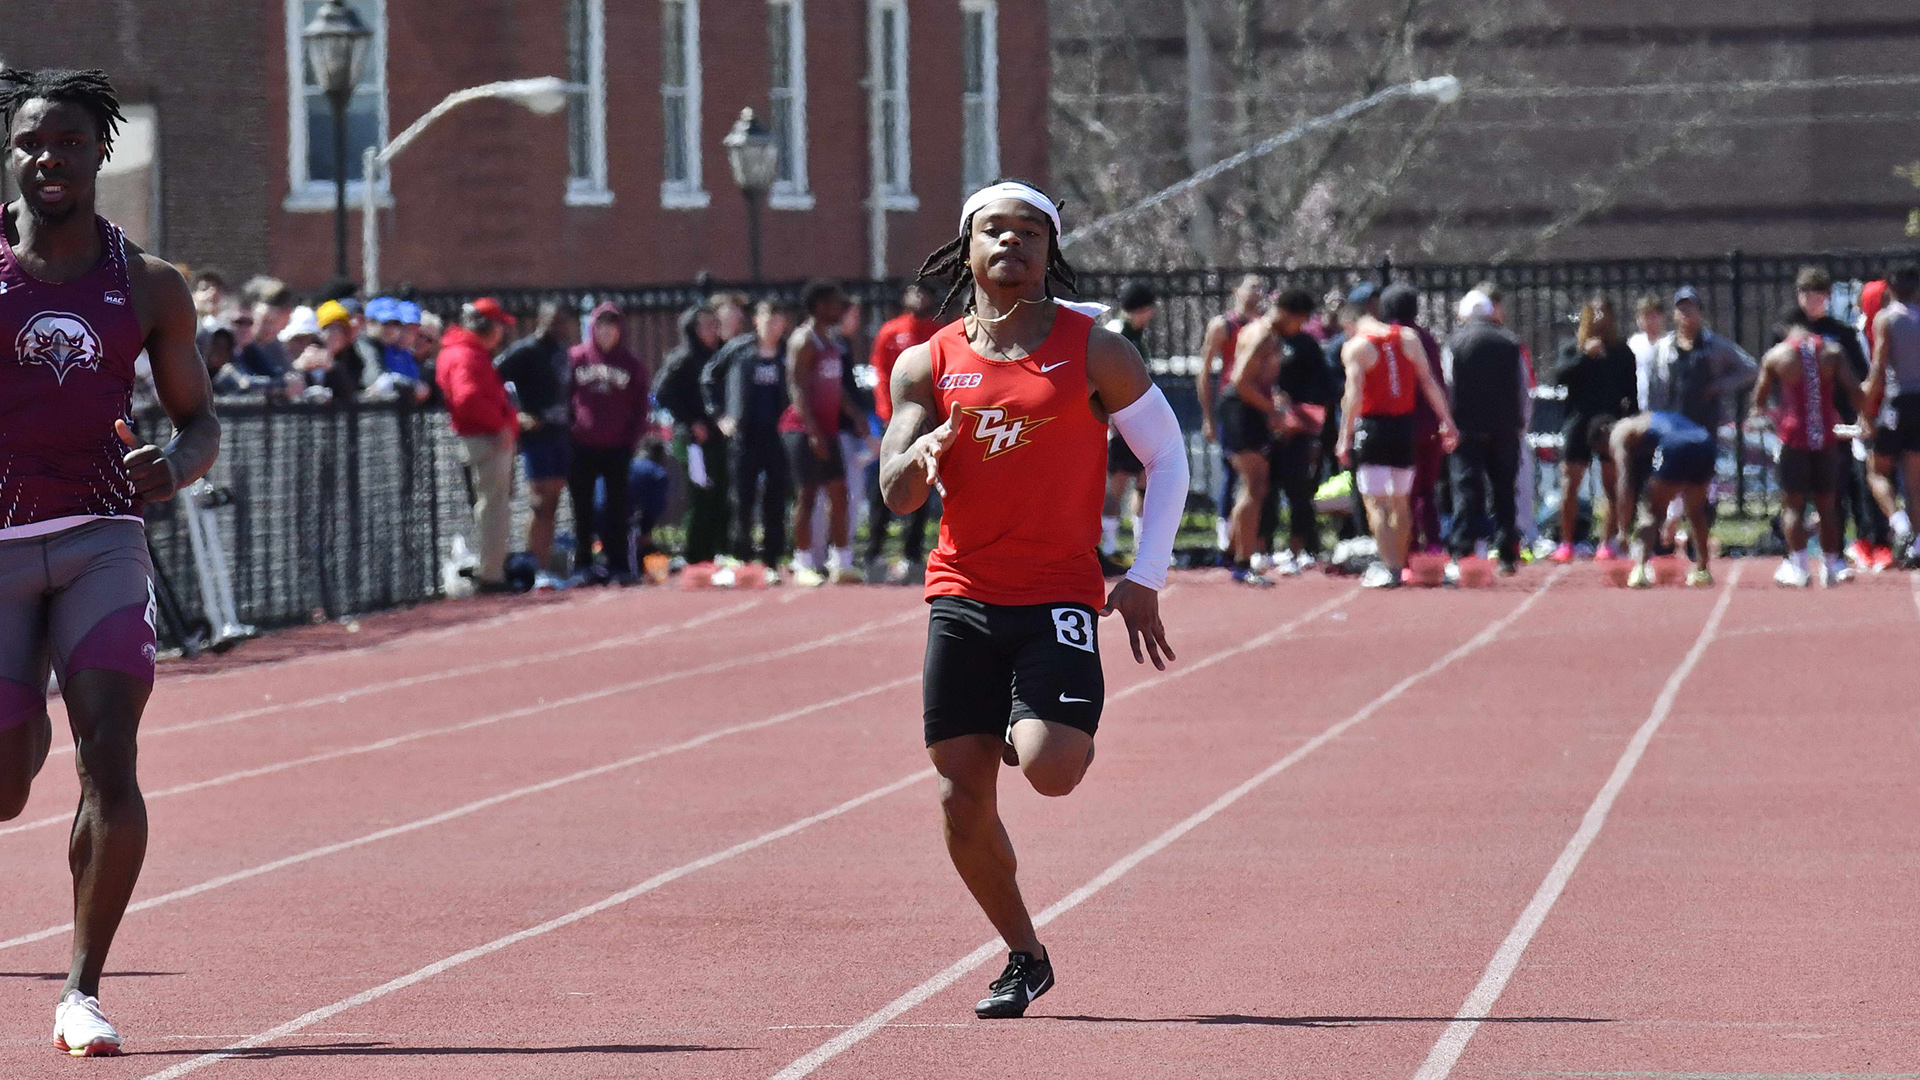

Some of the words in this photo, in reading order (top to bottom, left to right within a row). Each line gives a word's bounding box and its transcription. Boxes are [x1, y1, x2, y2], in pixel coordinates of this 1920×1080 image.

[106, 295, 124, 304] MAC
[938, 374, 982, 388] CACC
[970, 407, 1038, 457] CH
[1058, 610, 1087, 646] 3
